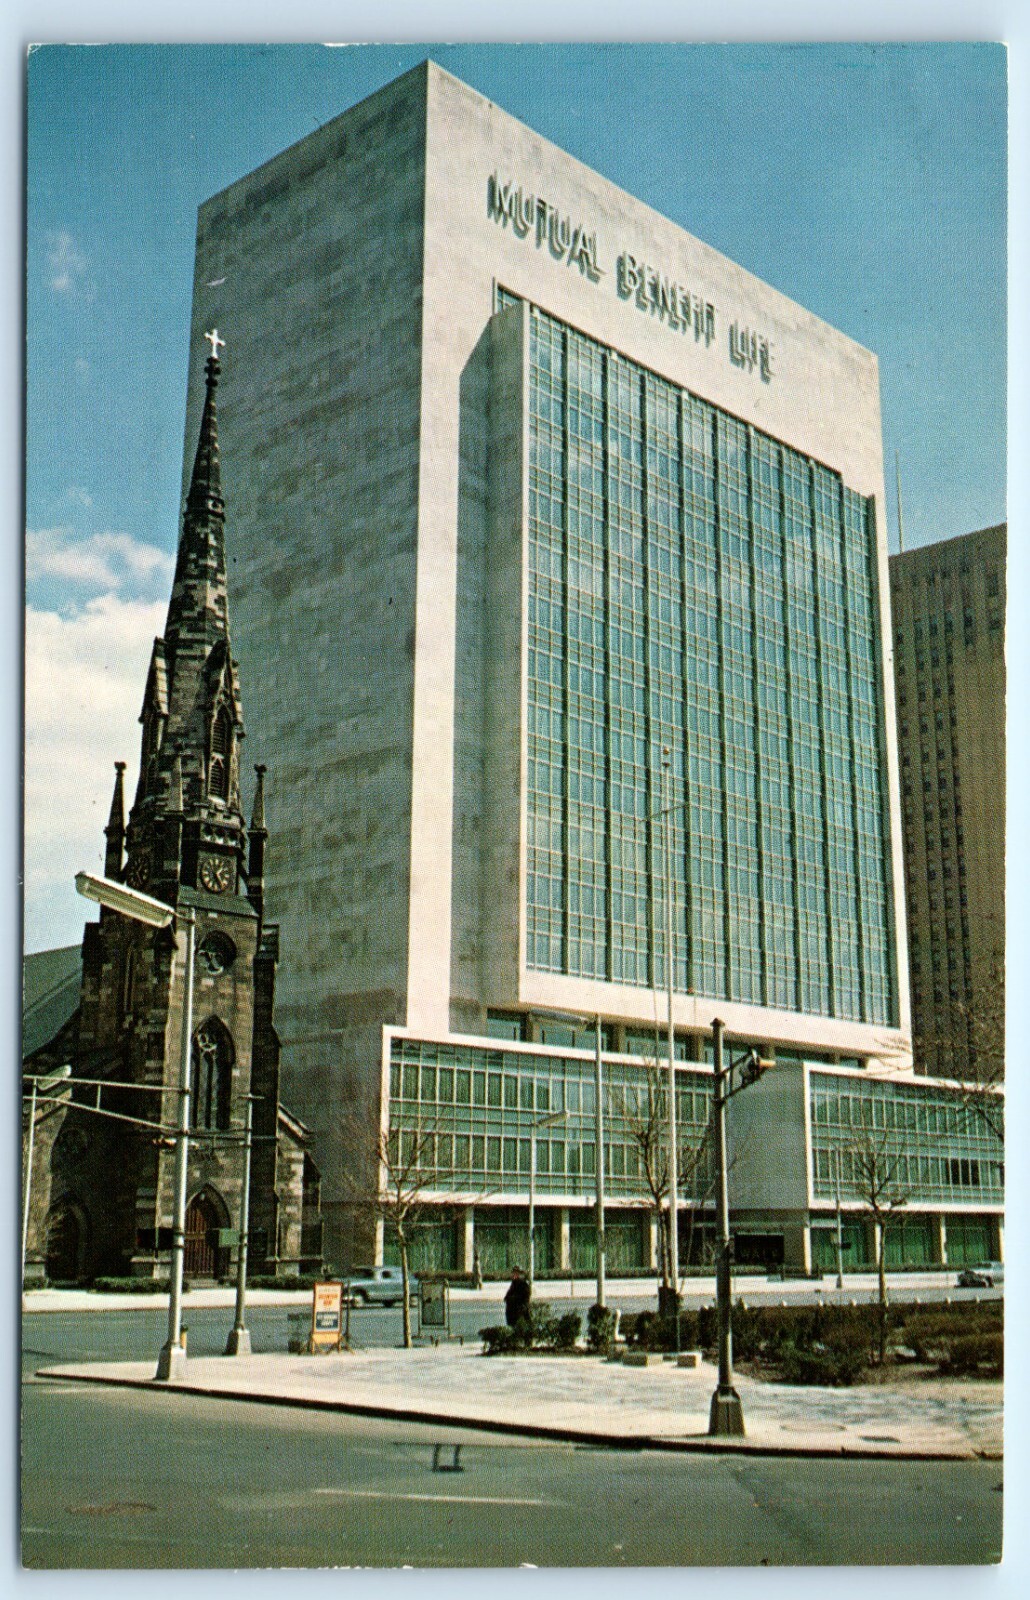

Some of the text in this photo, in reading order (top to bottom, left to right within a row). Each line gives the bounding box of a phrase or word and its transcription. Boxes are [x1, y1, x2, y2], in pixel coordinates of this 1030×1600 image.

[488, 171, 774, 383] MUTUAL BENEFIT LIFE
